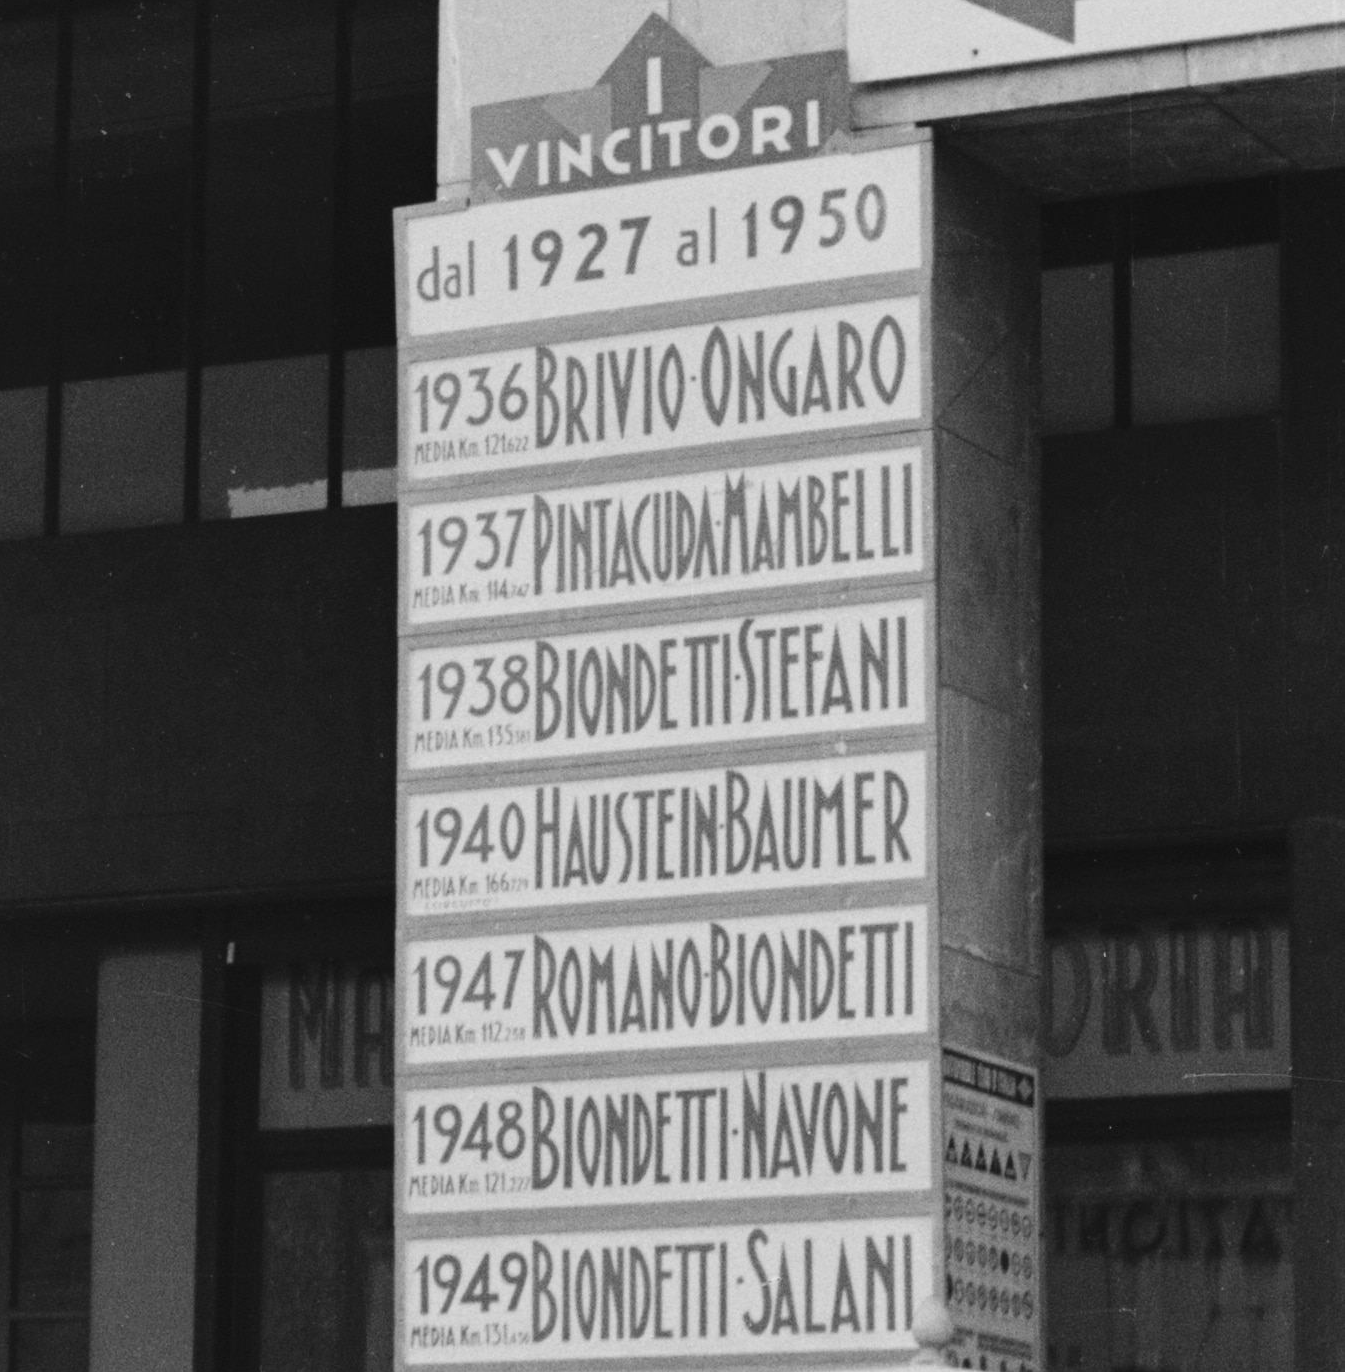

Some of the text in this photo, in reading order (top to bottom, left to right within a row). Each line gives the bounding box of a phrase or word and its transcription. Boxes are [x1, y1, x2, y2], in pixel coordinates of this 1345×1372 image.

[486, 99, 820, 188] VINCITORI
[416, 182, 888, 303] dal 1927 al 1950
[414, 362, 530, 433] 1936
[414, 440, 455, 465] MEDIA
[417, 508, 527, 577] 1937
[412, 584, 454, 609] MEDIA
[418, 655, 531, 721] 1938
[414, 731, 458, 753] MEDIA
[416, 801, 525, 868] 1940
[412, 877, 455, 900] MEDIA
[412, 949, 526, 1016] 1947
[410, 1024, 452, 1047] MEDIA
[412, 1101, 526, 1166] 1948
[409, 1174, 455, 1197] MEDIA
[414, 1251, 529, 1316] 1949
[411, 1326, 455, 1348] MEDIA
